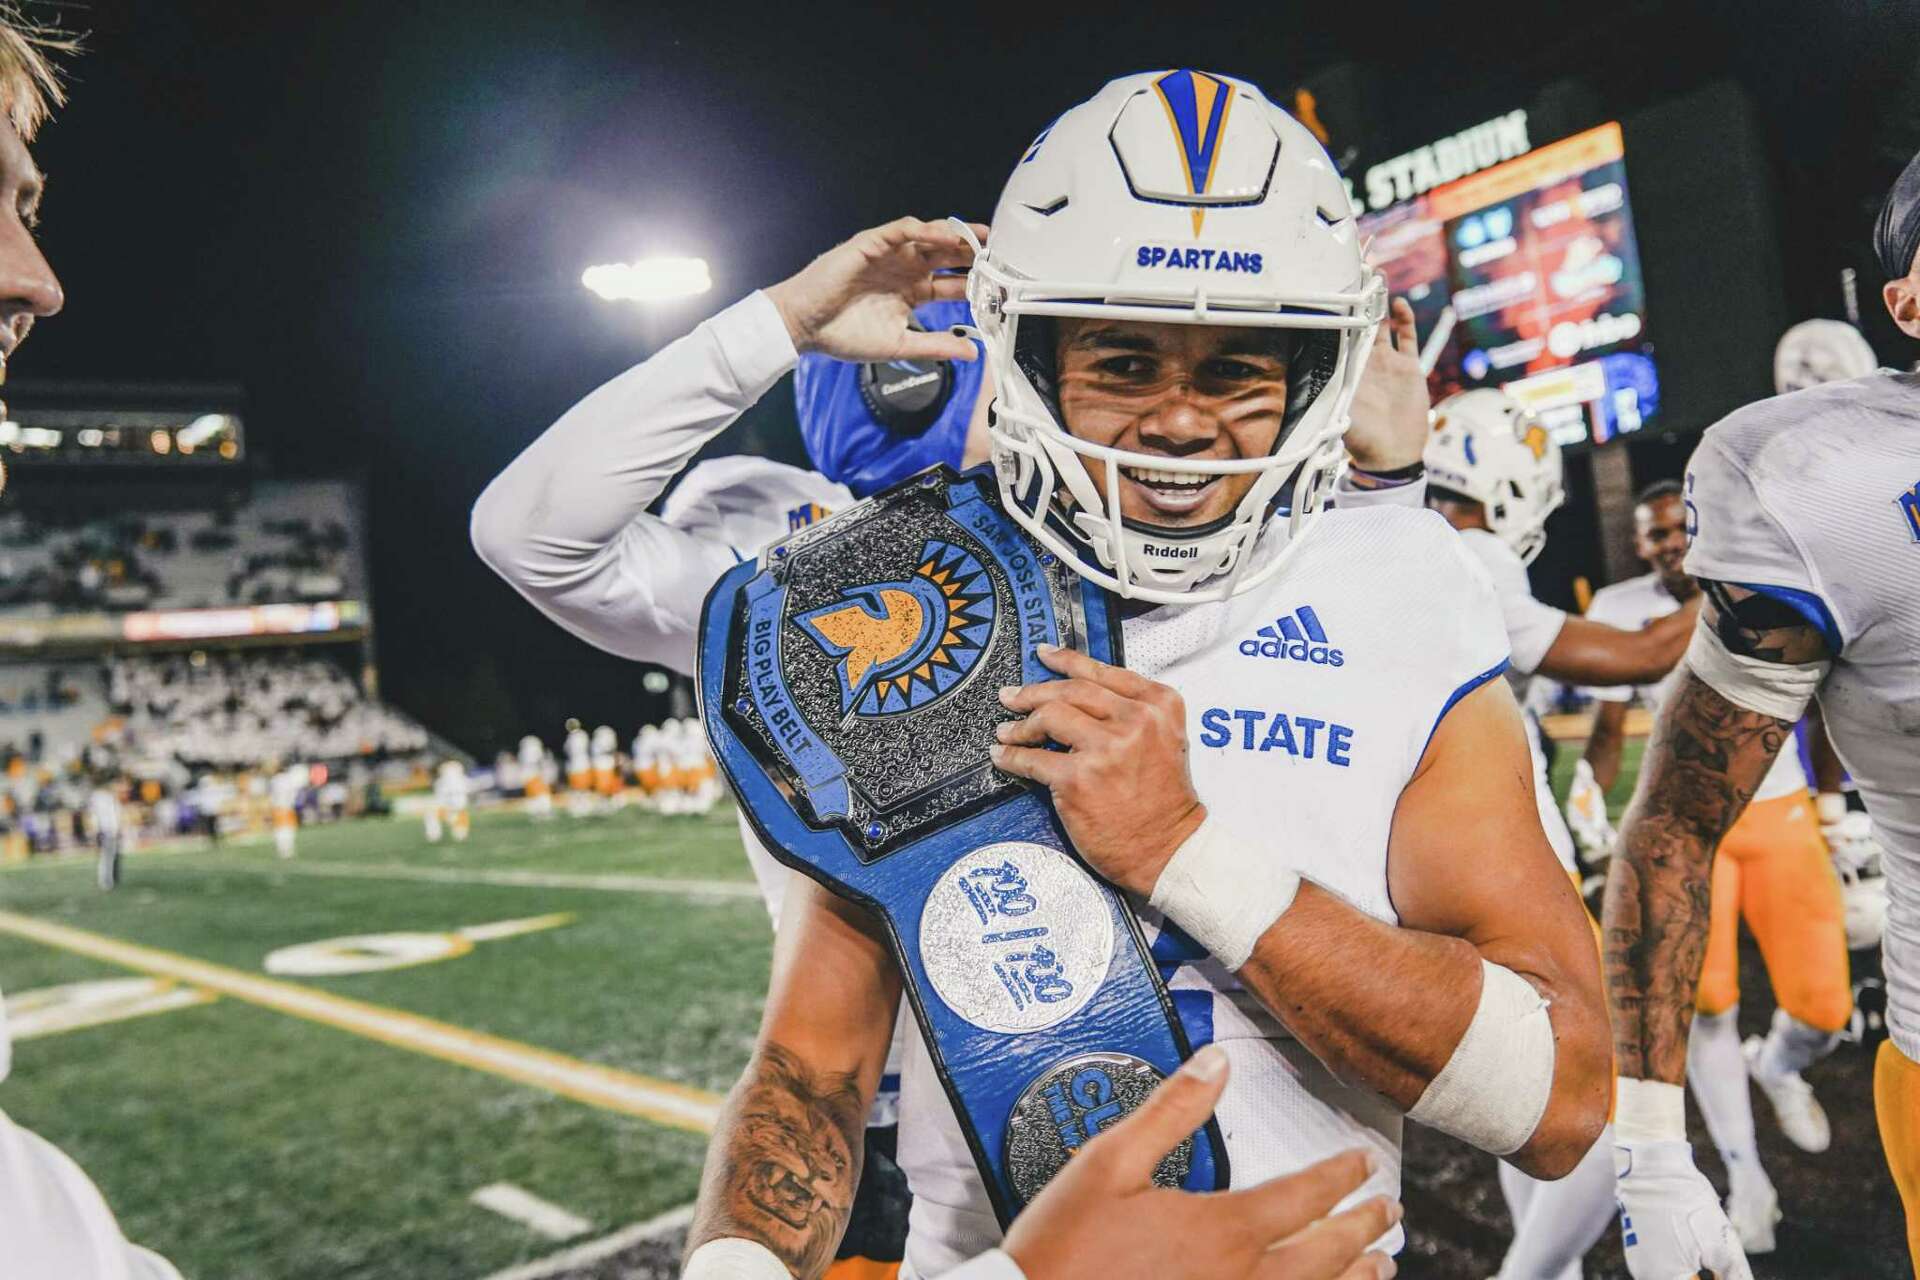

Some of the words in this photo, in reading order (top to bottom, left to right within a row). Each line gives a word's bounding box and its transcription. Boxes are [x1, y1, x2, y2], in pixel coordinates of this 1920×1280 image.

[1137, 246, 1262, 274] SPARTANS
[973, 515, 1009, 546] SAN
[1003, 543, 1036, 595] JOSE
[1143, 544, 1198, 558] Riddell
[754, 620, 772, 656] BIG
[1239, 638, 1344, 667] adidas
[754, 658, 783, 708] PLAY
[771, 707, 813, 755] BELT
[1200, 708, 1354, 767] STATE
